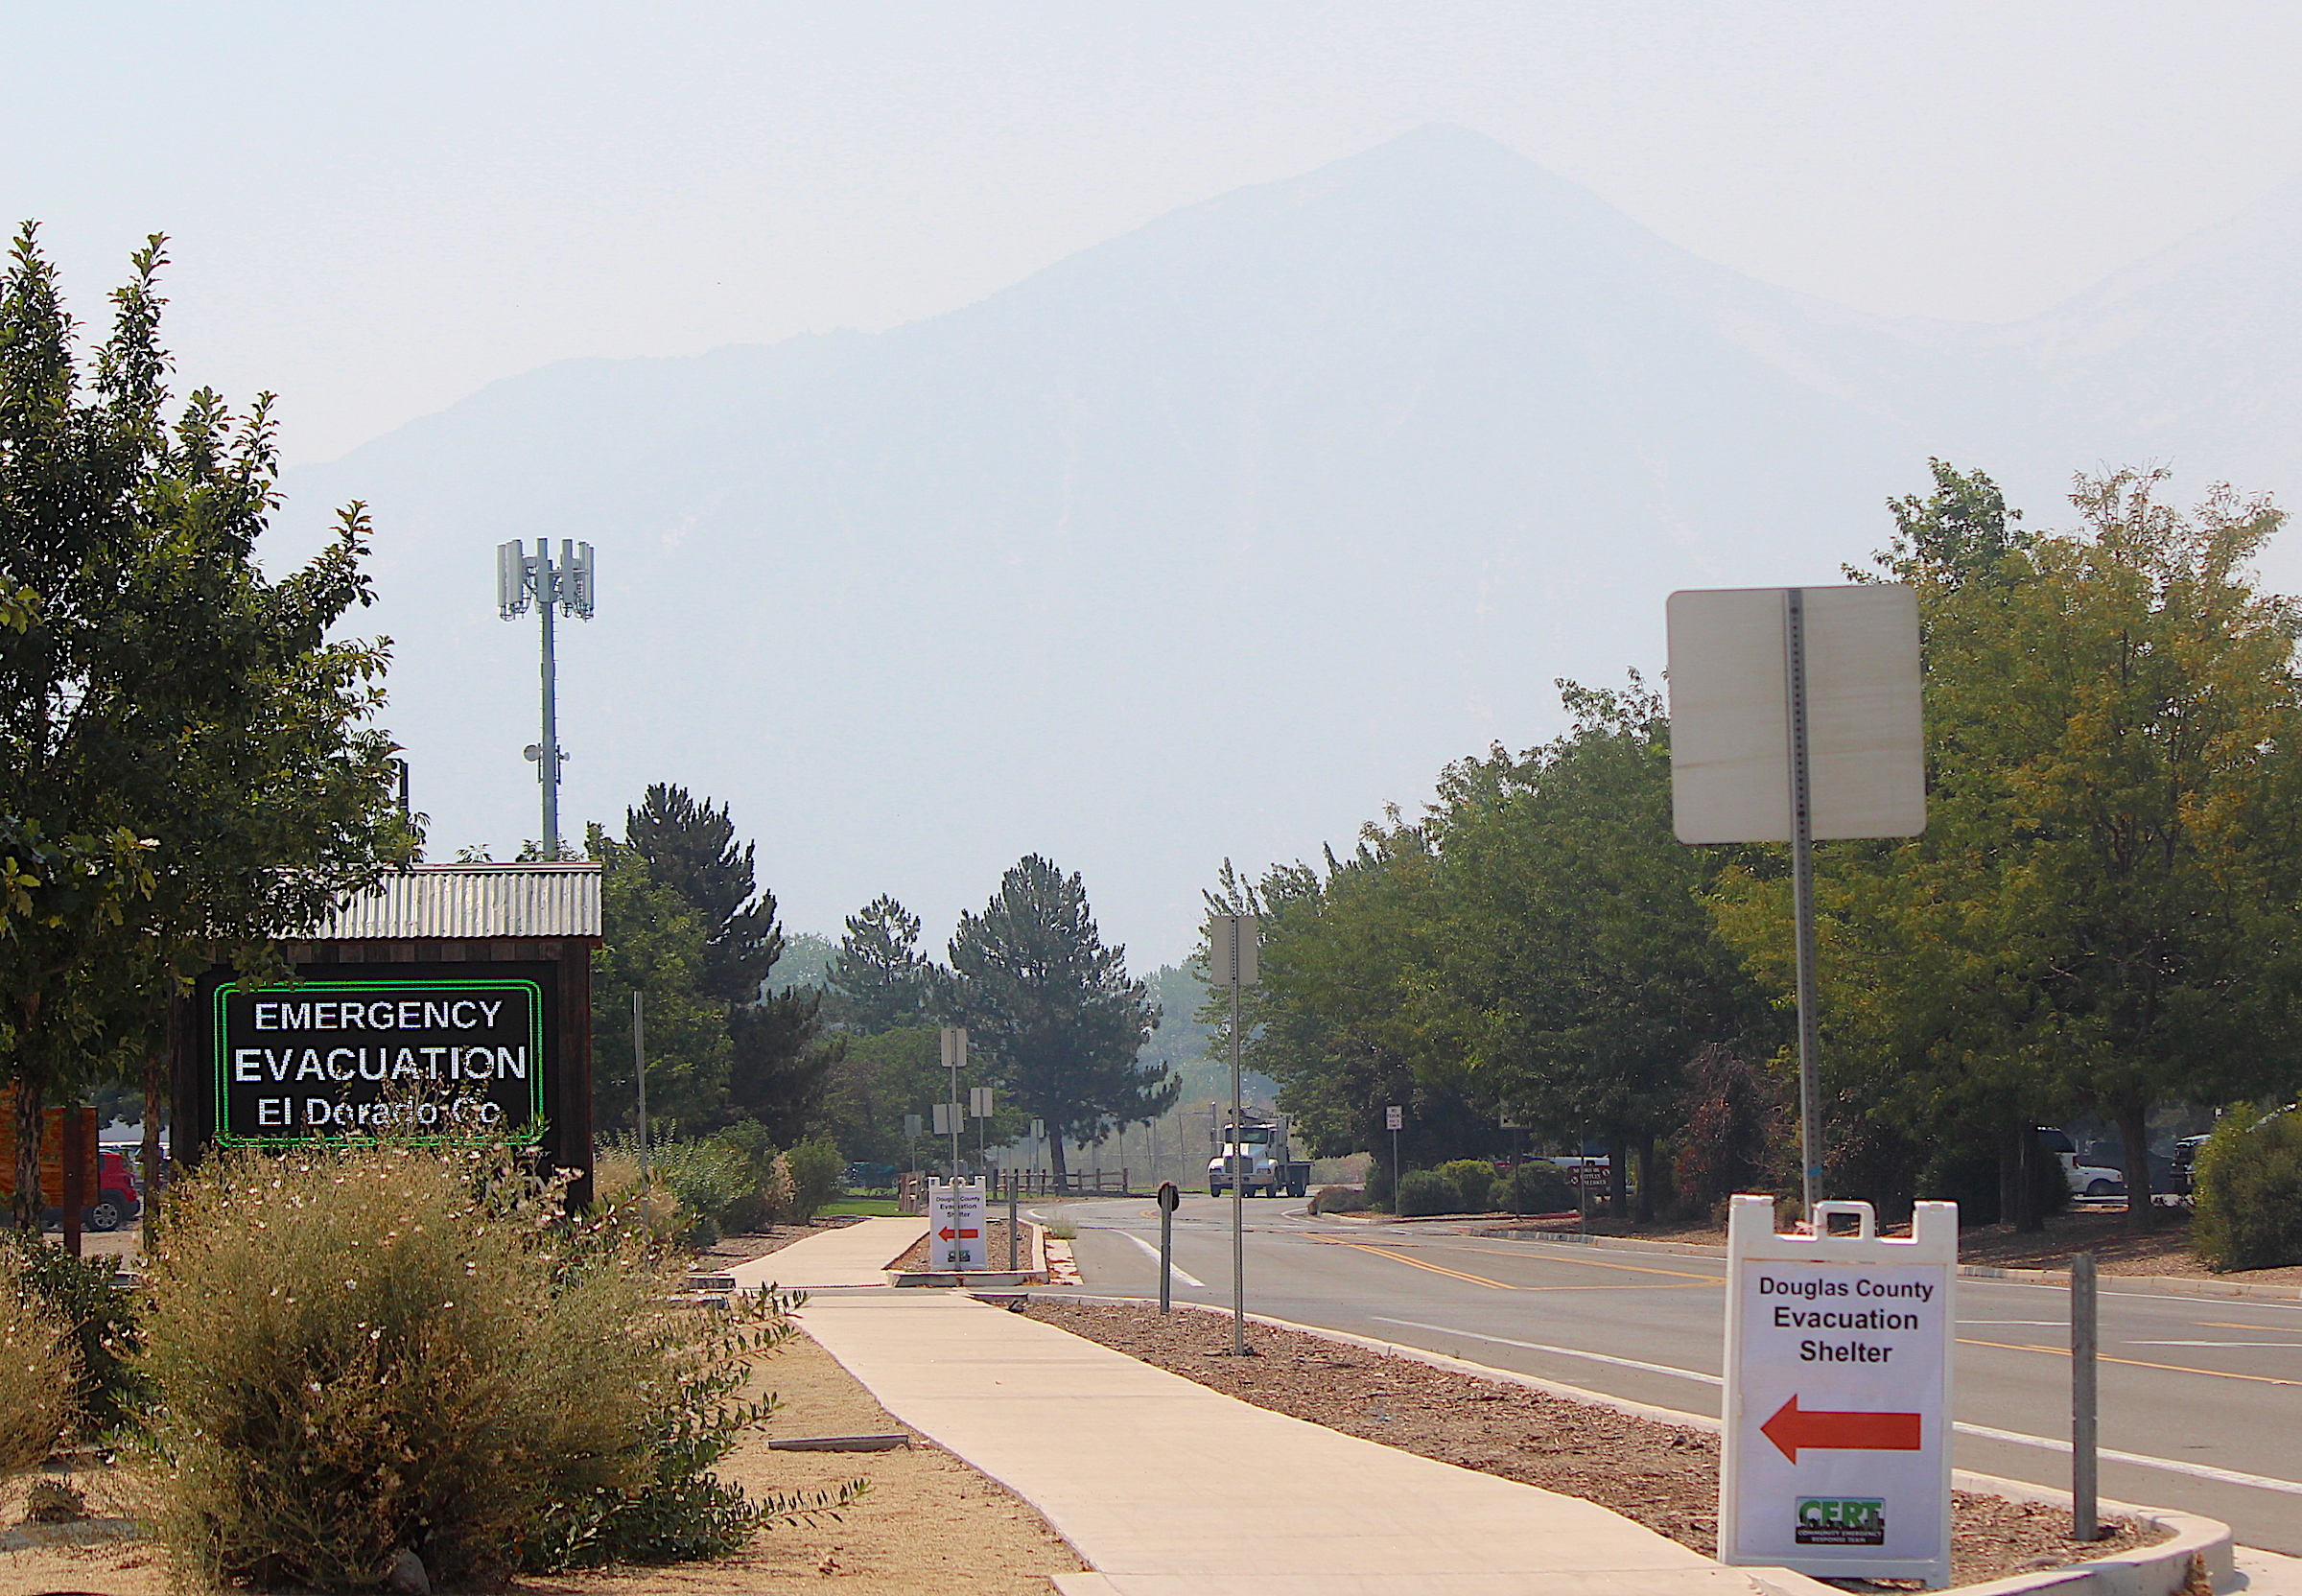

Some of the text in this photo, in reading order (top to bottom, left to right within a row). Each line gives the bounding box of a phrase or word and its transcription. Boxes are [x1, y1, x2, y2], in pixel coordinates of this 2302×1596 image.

[255, 1000, 503, 1030] EMERGENCY
[235, 1046, 526, 1082] EVACUATION
[258, 1097, 291, 1125] El
[1759, 1277, 1934, 1303] Douglas County
[1774, 1305, 1917, 1330] Evacuation
[1799, 1340, 1893, 1363] Shelter
[1798, 1500, 1882, 1530] CERT
